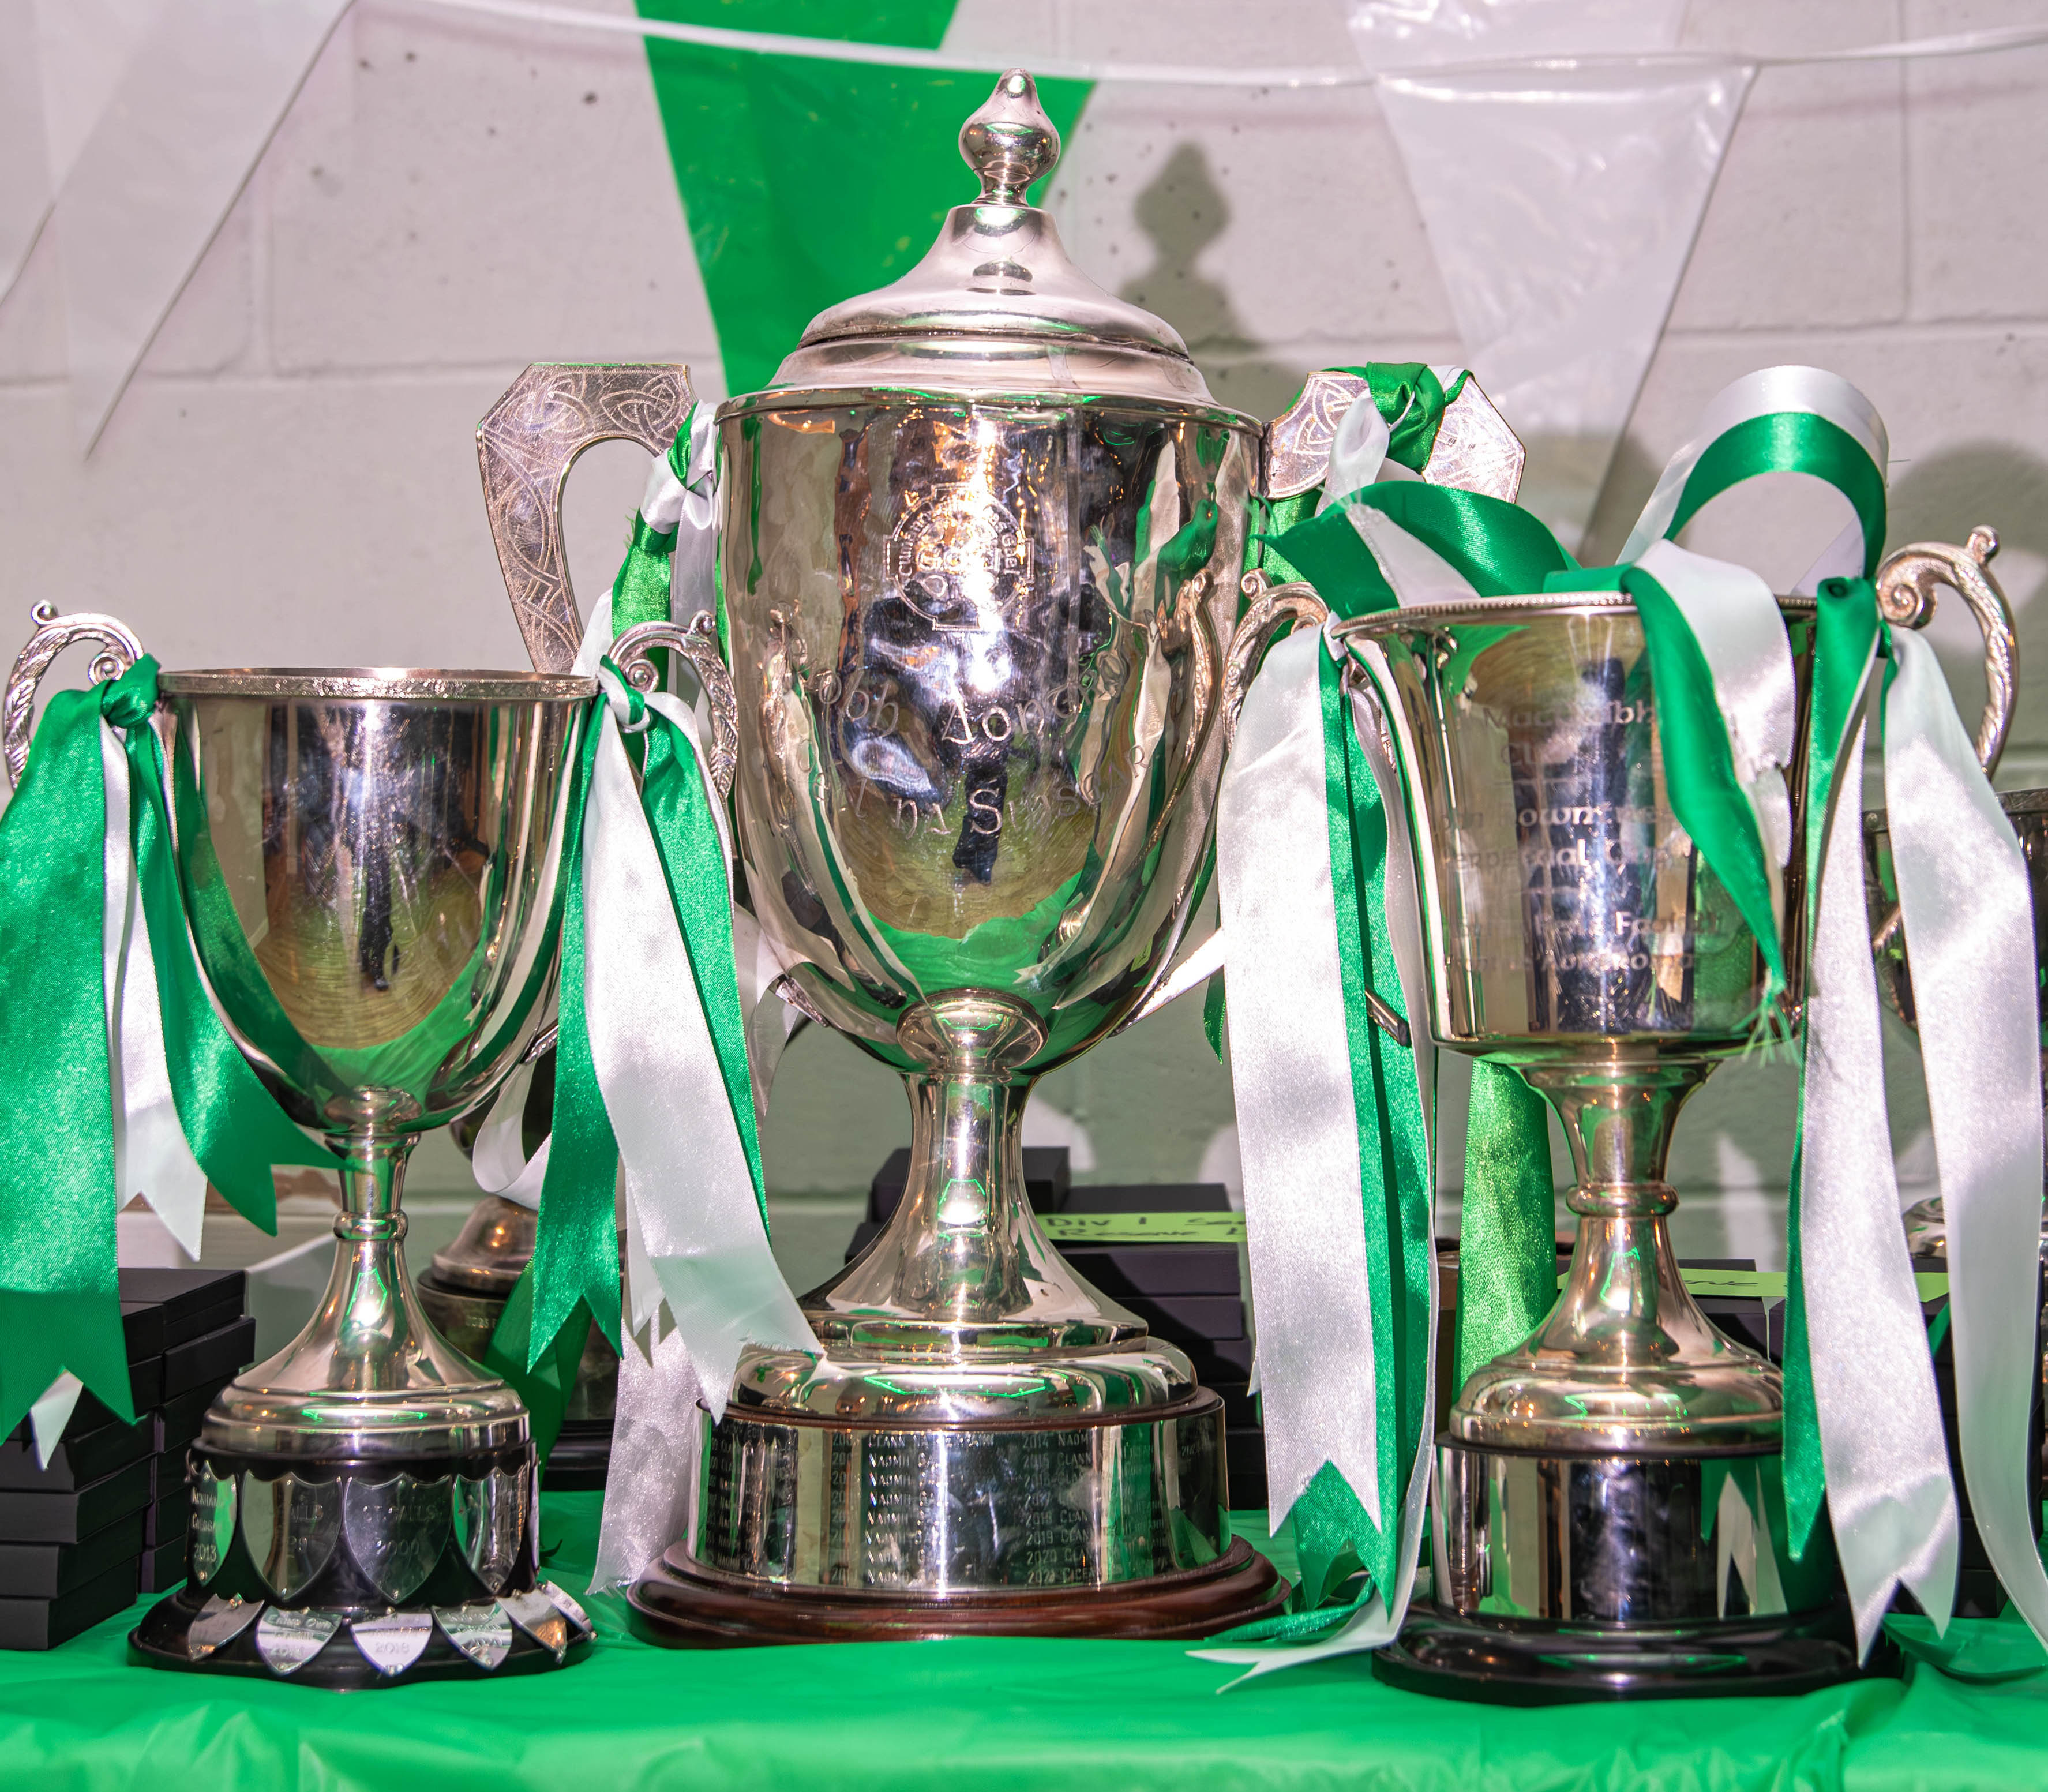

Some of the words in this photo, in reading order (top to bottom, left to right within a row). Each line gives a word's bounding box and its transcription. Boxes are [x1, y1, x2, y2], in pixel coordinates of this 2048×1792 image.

[1045, 1217, 1111, 1227] Div
[1060, 1509, 1092, 1523] CLAN
[1061, 1528, 1092, 1544] CLAN
[194, 1542, 217, 1564] 2013
